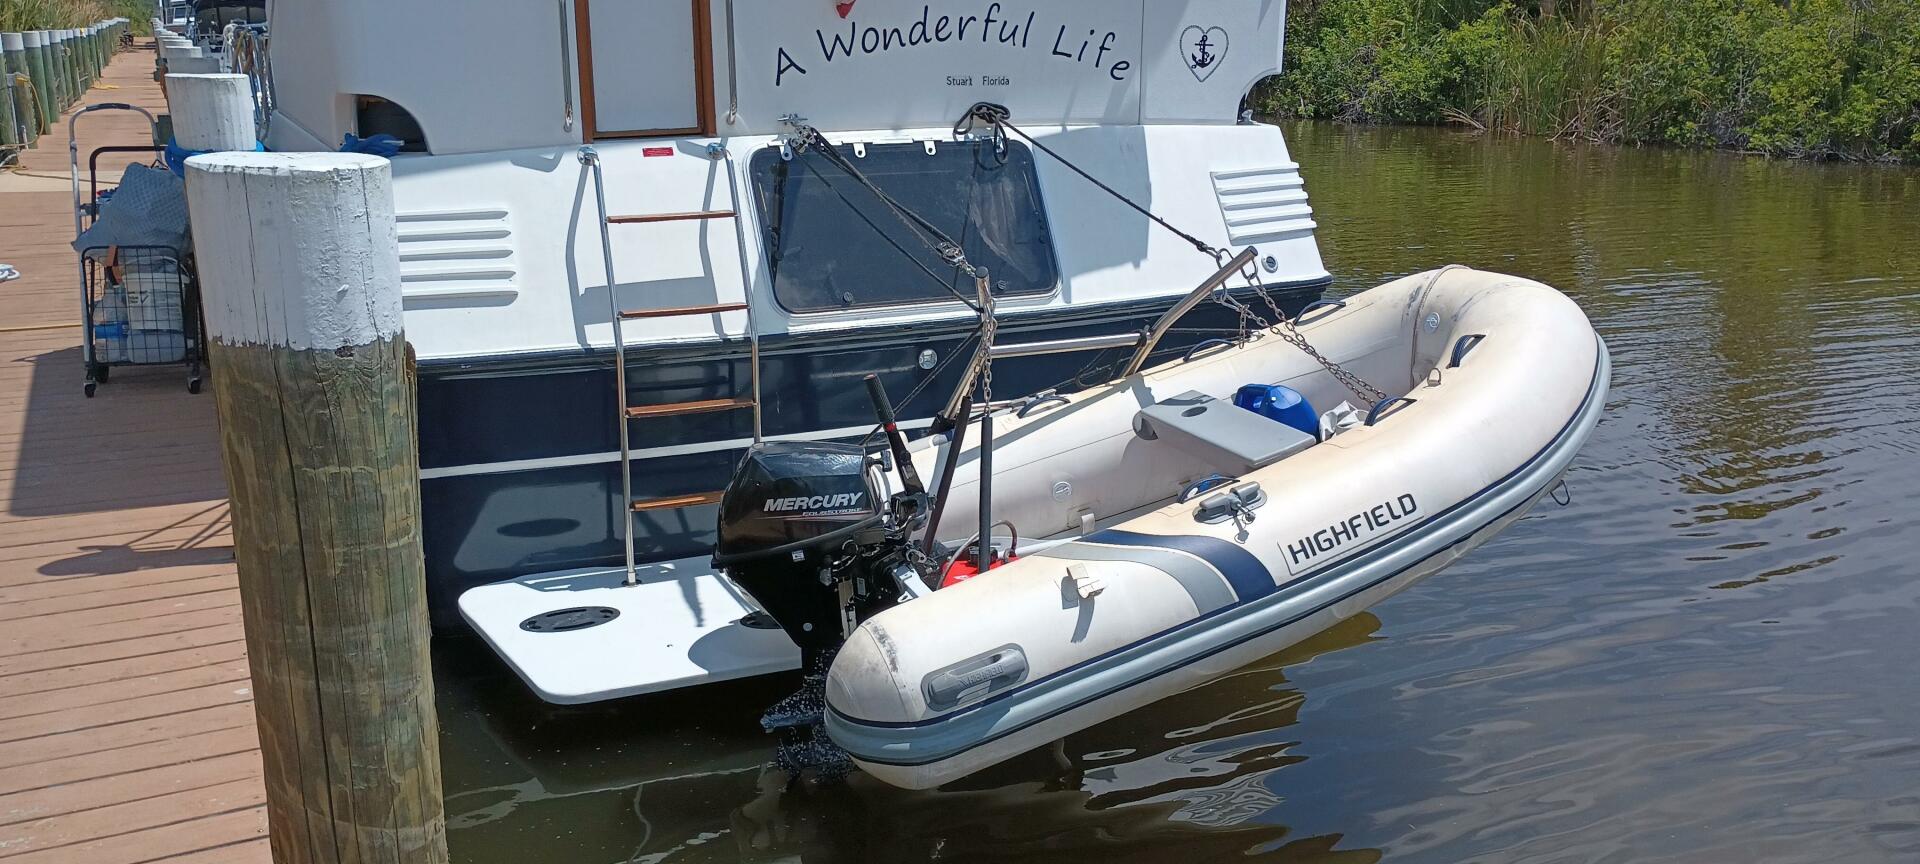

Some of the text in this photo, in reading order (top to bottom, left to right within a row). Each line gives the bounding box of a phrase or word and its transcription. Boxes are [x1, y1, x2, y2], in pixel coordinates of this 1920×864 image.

[775, 2, 1131, 86] A Wonderful Life
[946, 75, 1010, 86] Stuart Florida
[763, 491, 864, 512] MERCURY
[1287, 493, 1417, 565] HIGHFIELD
